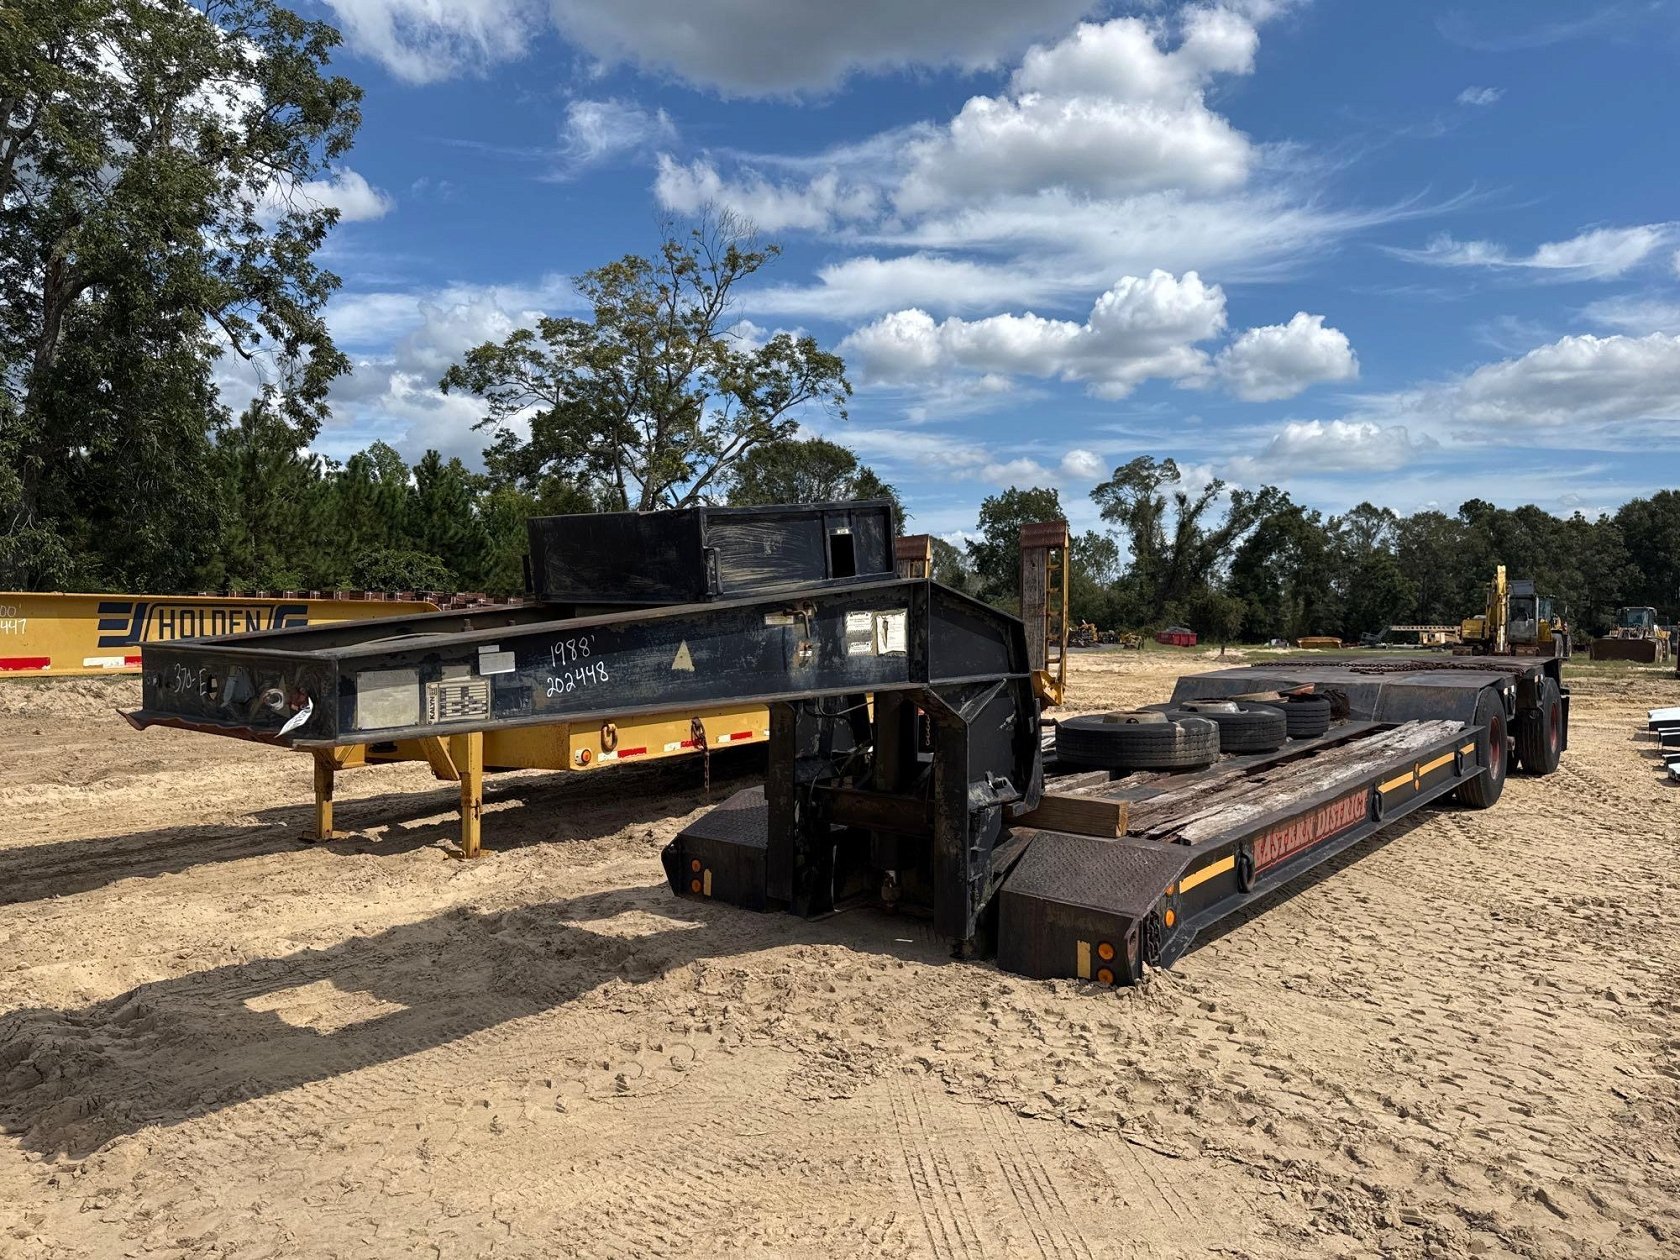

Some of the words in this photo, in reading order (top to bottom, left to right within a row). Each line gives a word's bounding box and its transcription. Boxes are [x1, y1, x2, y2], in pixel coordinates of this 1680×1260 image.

[158, 609, 261, 640] HOLDEN
[546, 661, 609, 698] 202448
[1253, 815, 1315, 869] EASTERN
[1315, 788, 1369, 838] DISTRICT
